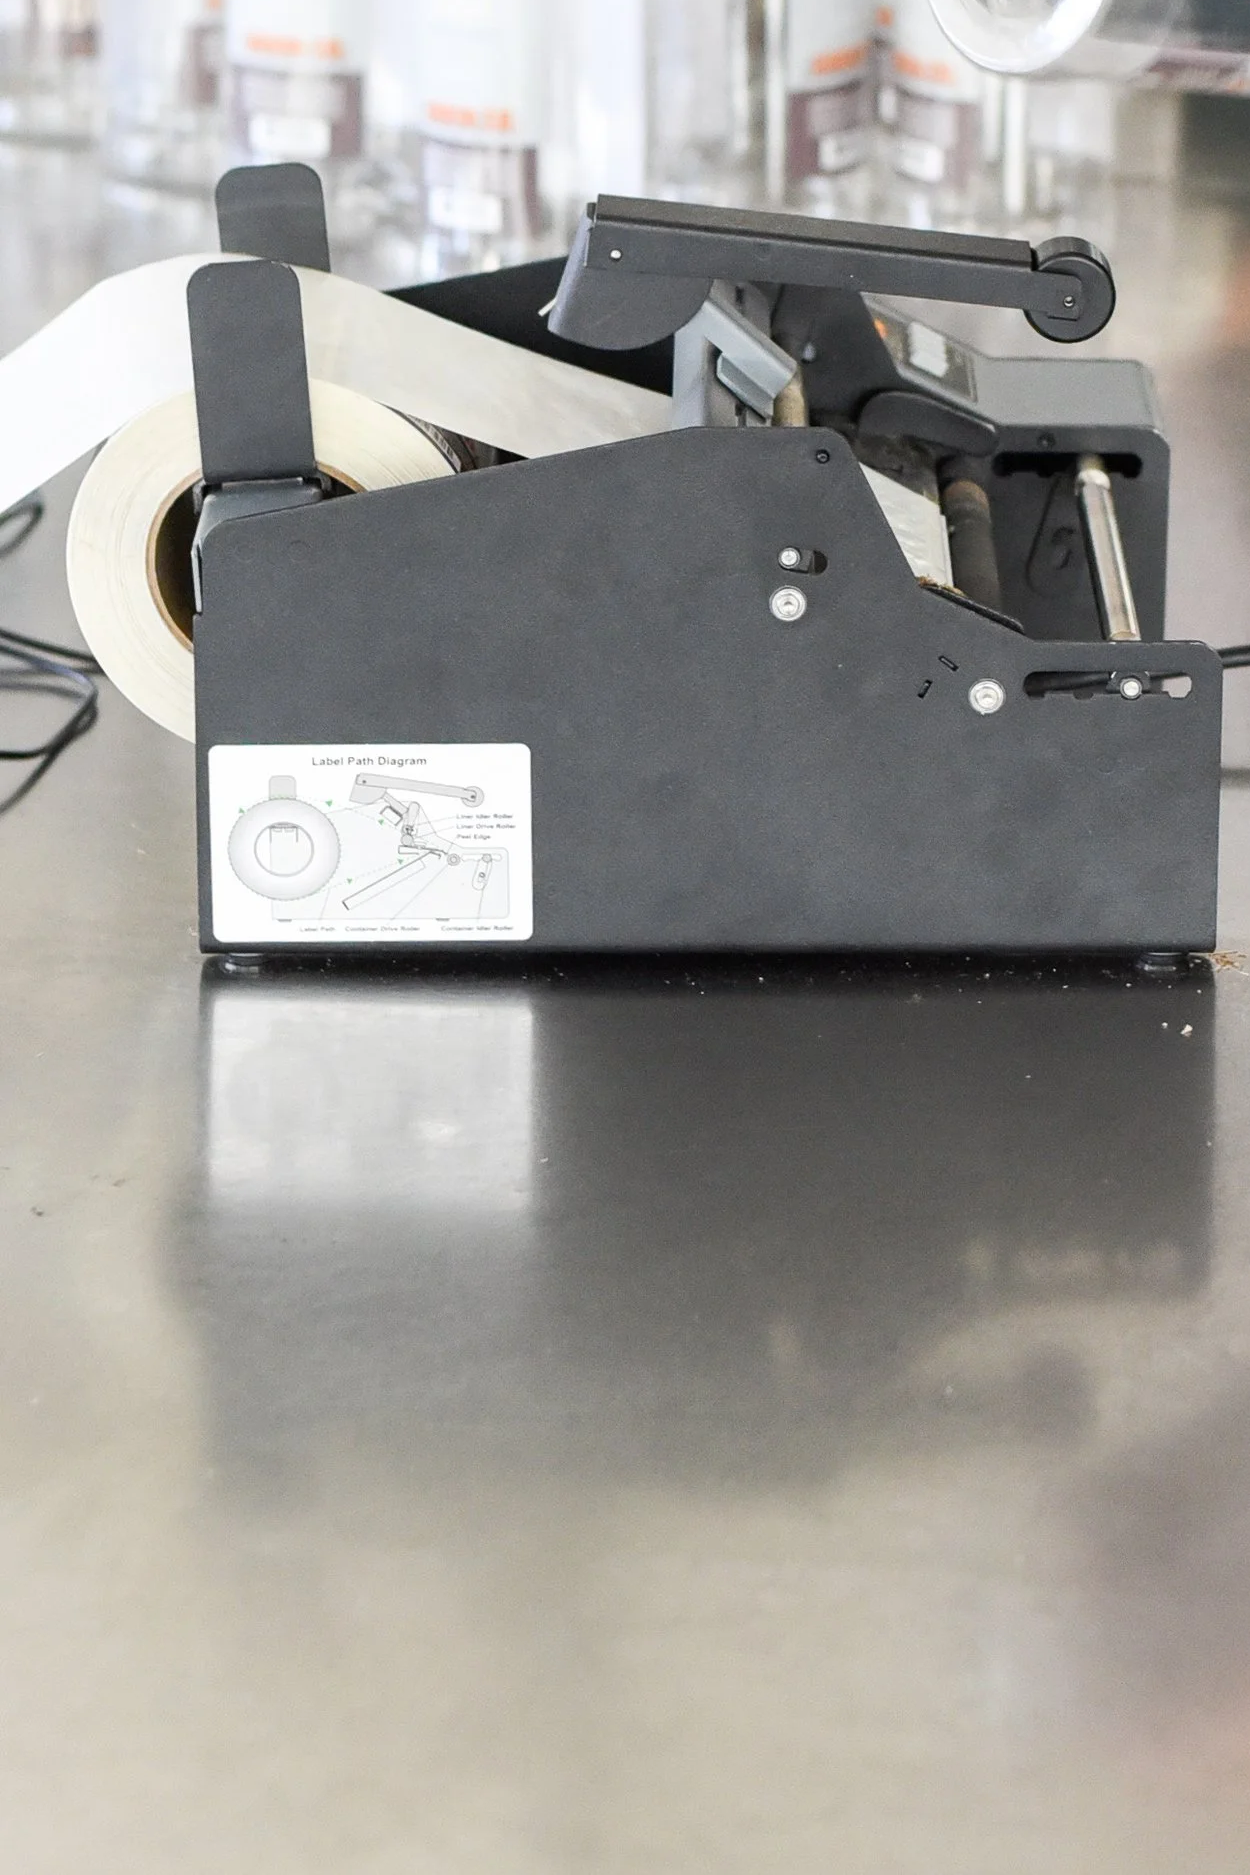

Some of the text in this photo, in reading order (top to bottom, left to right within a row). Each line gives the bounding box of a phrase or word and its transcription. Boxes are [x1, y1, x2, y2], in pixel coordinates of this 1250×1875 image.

[311, 756, 428, 768] Label Path Diagram
